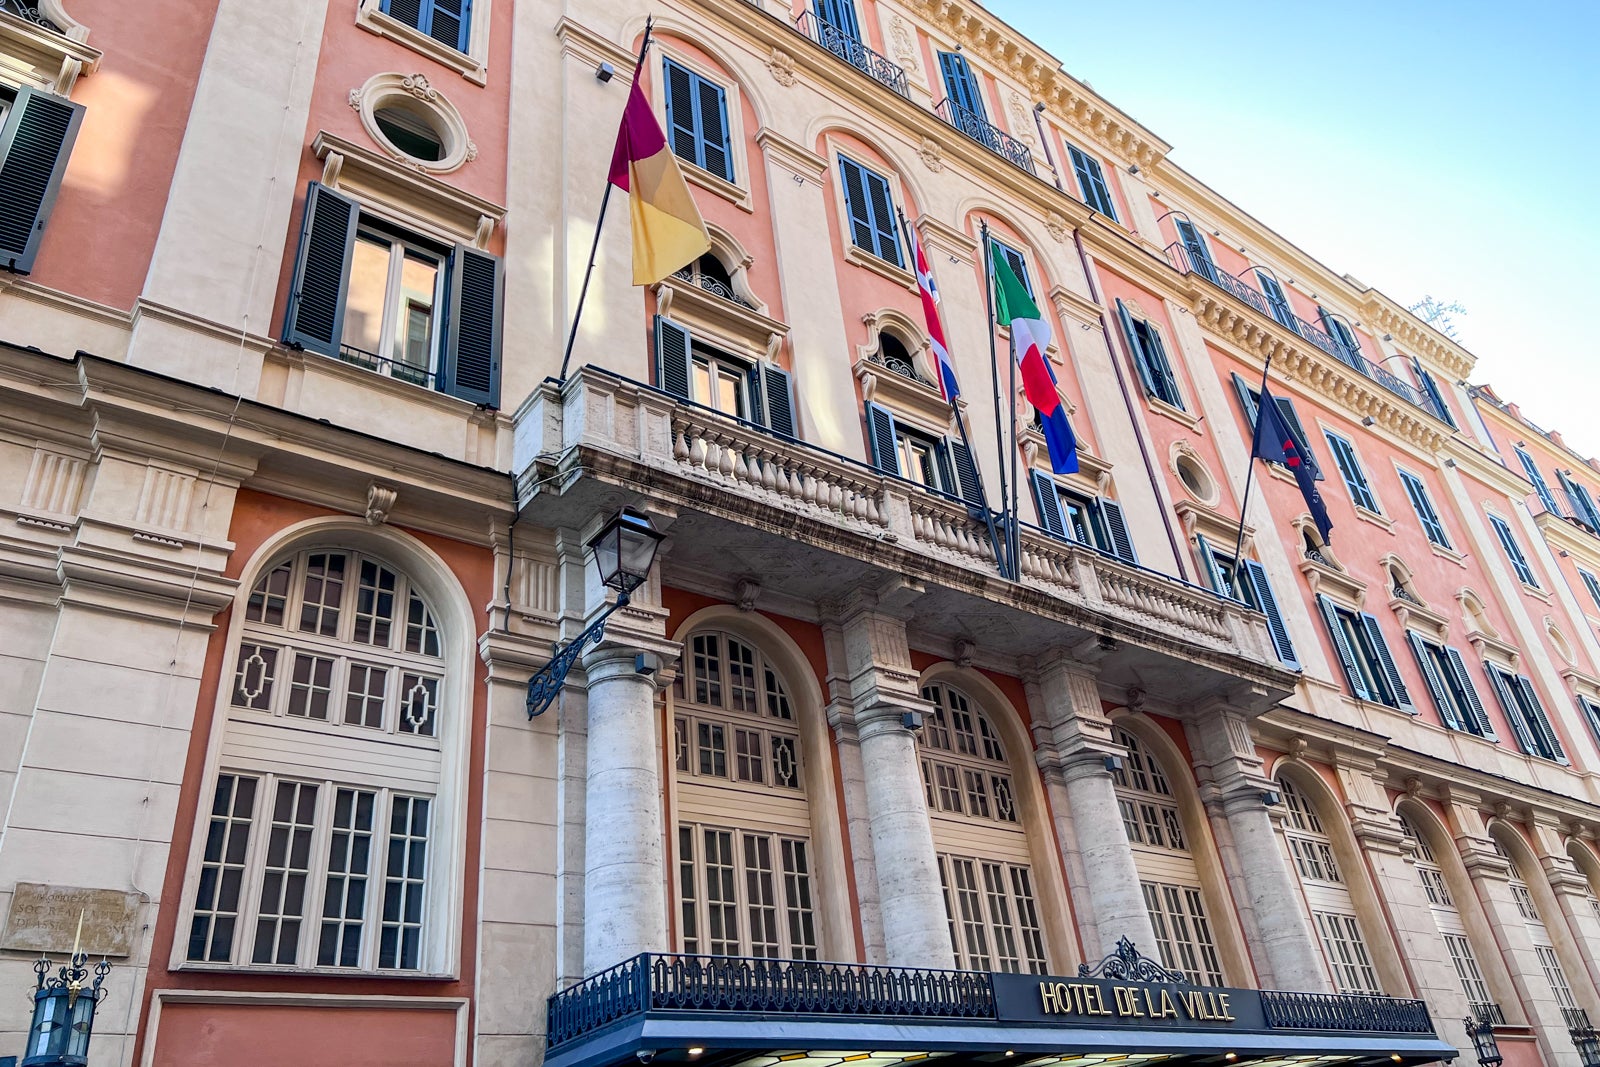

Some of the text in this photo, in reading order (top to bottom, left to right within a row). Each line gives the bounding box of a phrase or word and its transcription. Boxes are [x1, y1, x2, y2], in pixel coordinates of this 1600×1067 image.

[1039, 981, 1236, 1022] HOTEL DE LA VILLE
